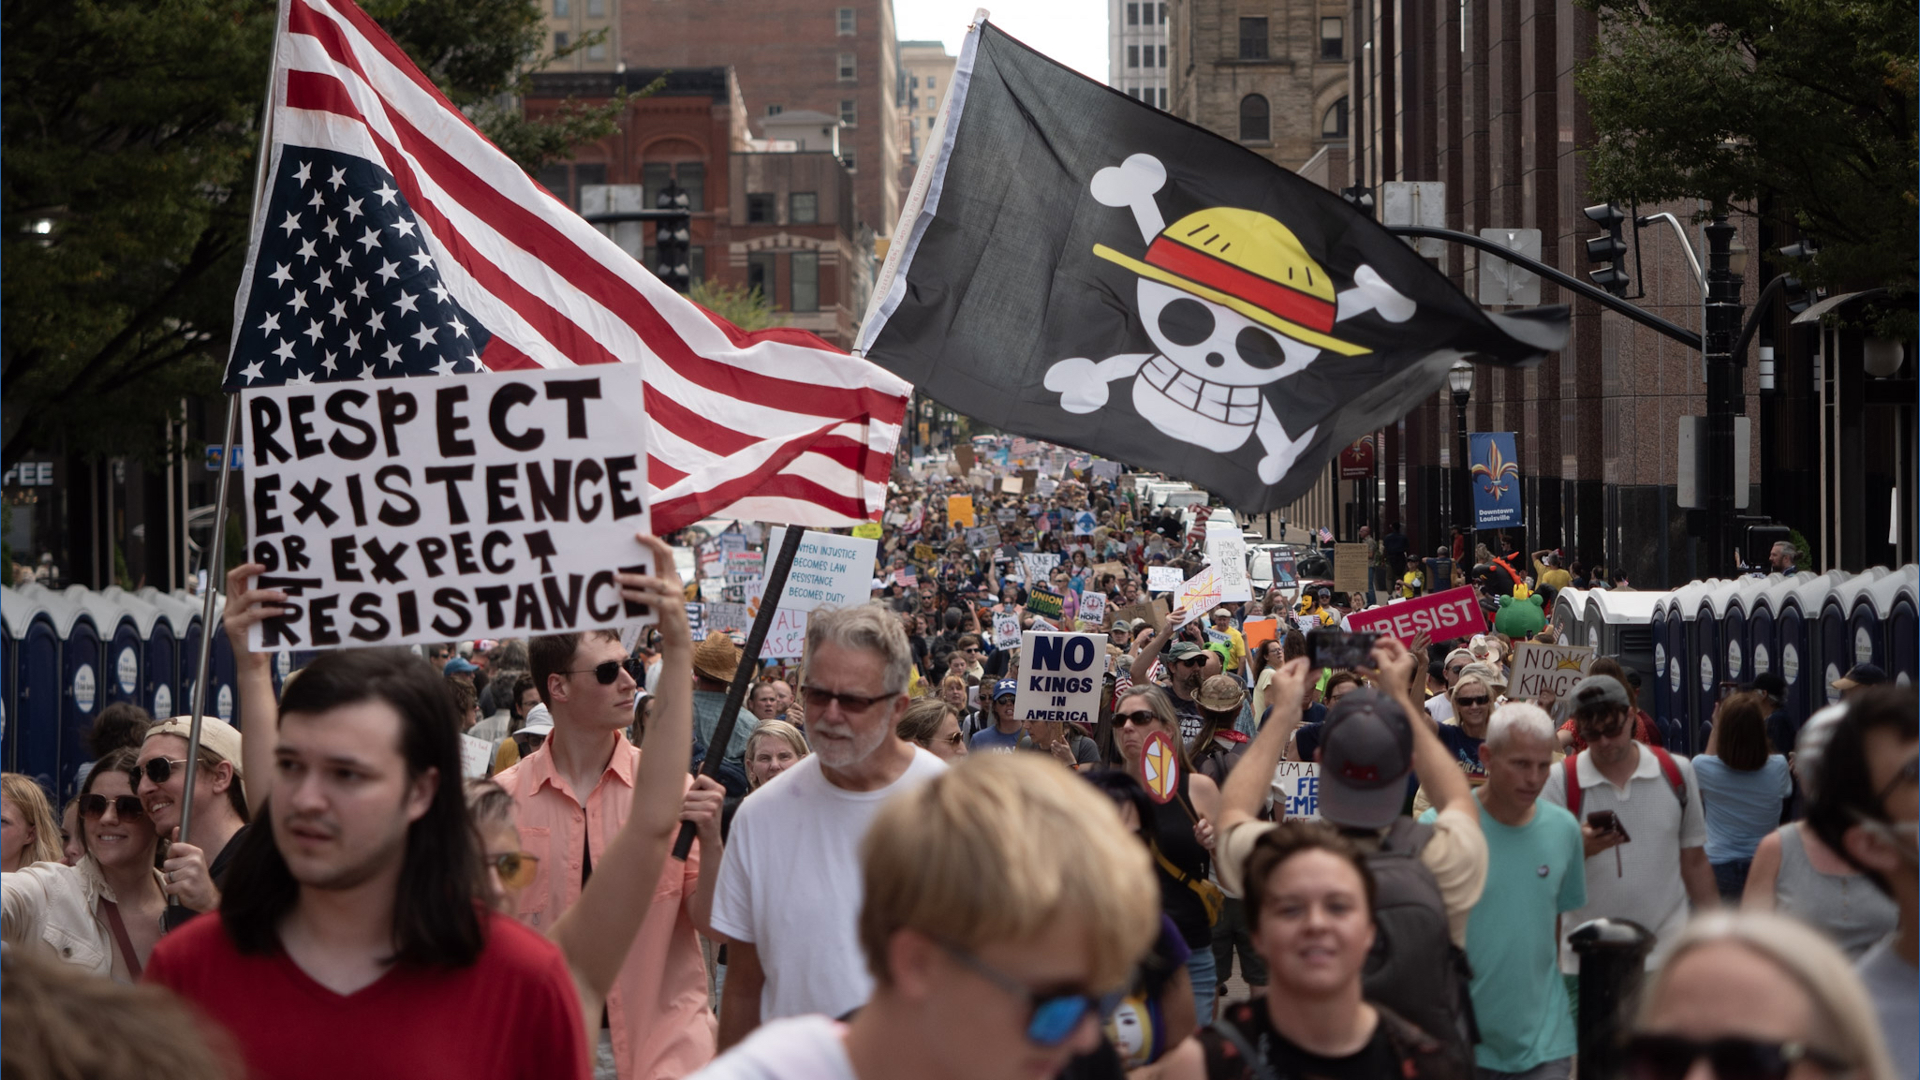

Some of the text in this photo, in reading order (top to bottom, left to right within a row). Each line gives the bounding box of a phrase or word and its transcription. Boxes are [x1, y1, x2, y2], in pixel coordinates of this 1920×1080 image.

[250, 377, 602, 466] RESPECT
[252, 454, 643, 537] EXISTENCE
[1478, 508, 1514, 516] Downtown
[1479, 515, 1511, 523] Louisville
[253, 530, 558, 585] OR EXPECT
[798, 543, 857, 560] WHEN INJUSTICE
[793, 557, 847, 573] BECOMES LAW
[1221, 556, 1237, 567] NOT
[790, 571, 834, 587] RESISTANCE
[748, 584, 761, 594] MY
[788, 586, 846, 603] BECOMES DUTY
[262, 564, 650, 648] RESISTANCE
[1031, 589, 1063, 607] UNION
[709, 602, 731, 615] ICE
[1027, 598, 1062, 616] STRONG
[1361, 598, 1473, 639] #RESIST
[786, 632, 798, 640] OF
[1000, 640, 1021, 648] HOPE
[1032, 635, 1095, 672] NO
[1524, 648, 1554, 670] NO
[999, 680, 1016, 689] K
[1030, 675, 1093, 694] KINGS
[1051, 696, 1067, 707] IN
[1026, 709, 1089, 722] AMERICA
[1280, 762, 1314, 777] I'M A
